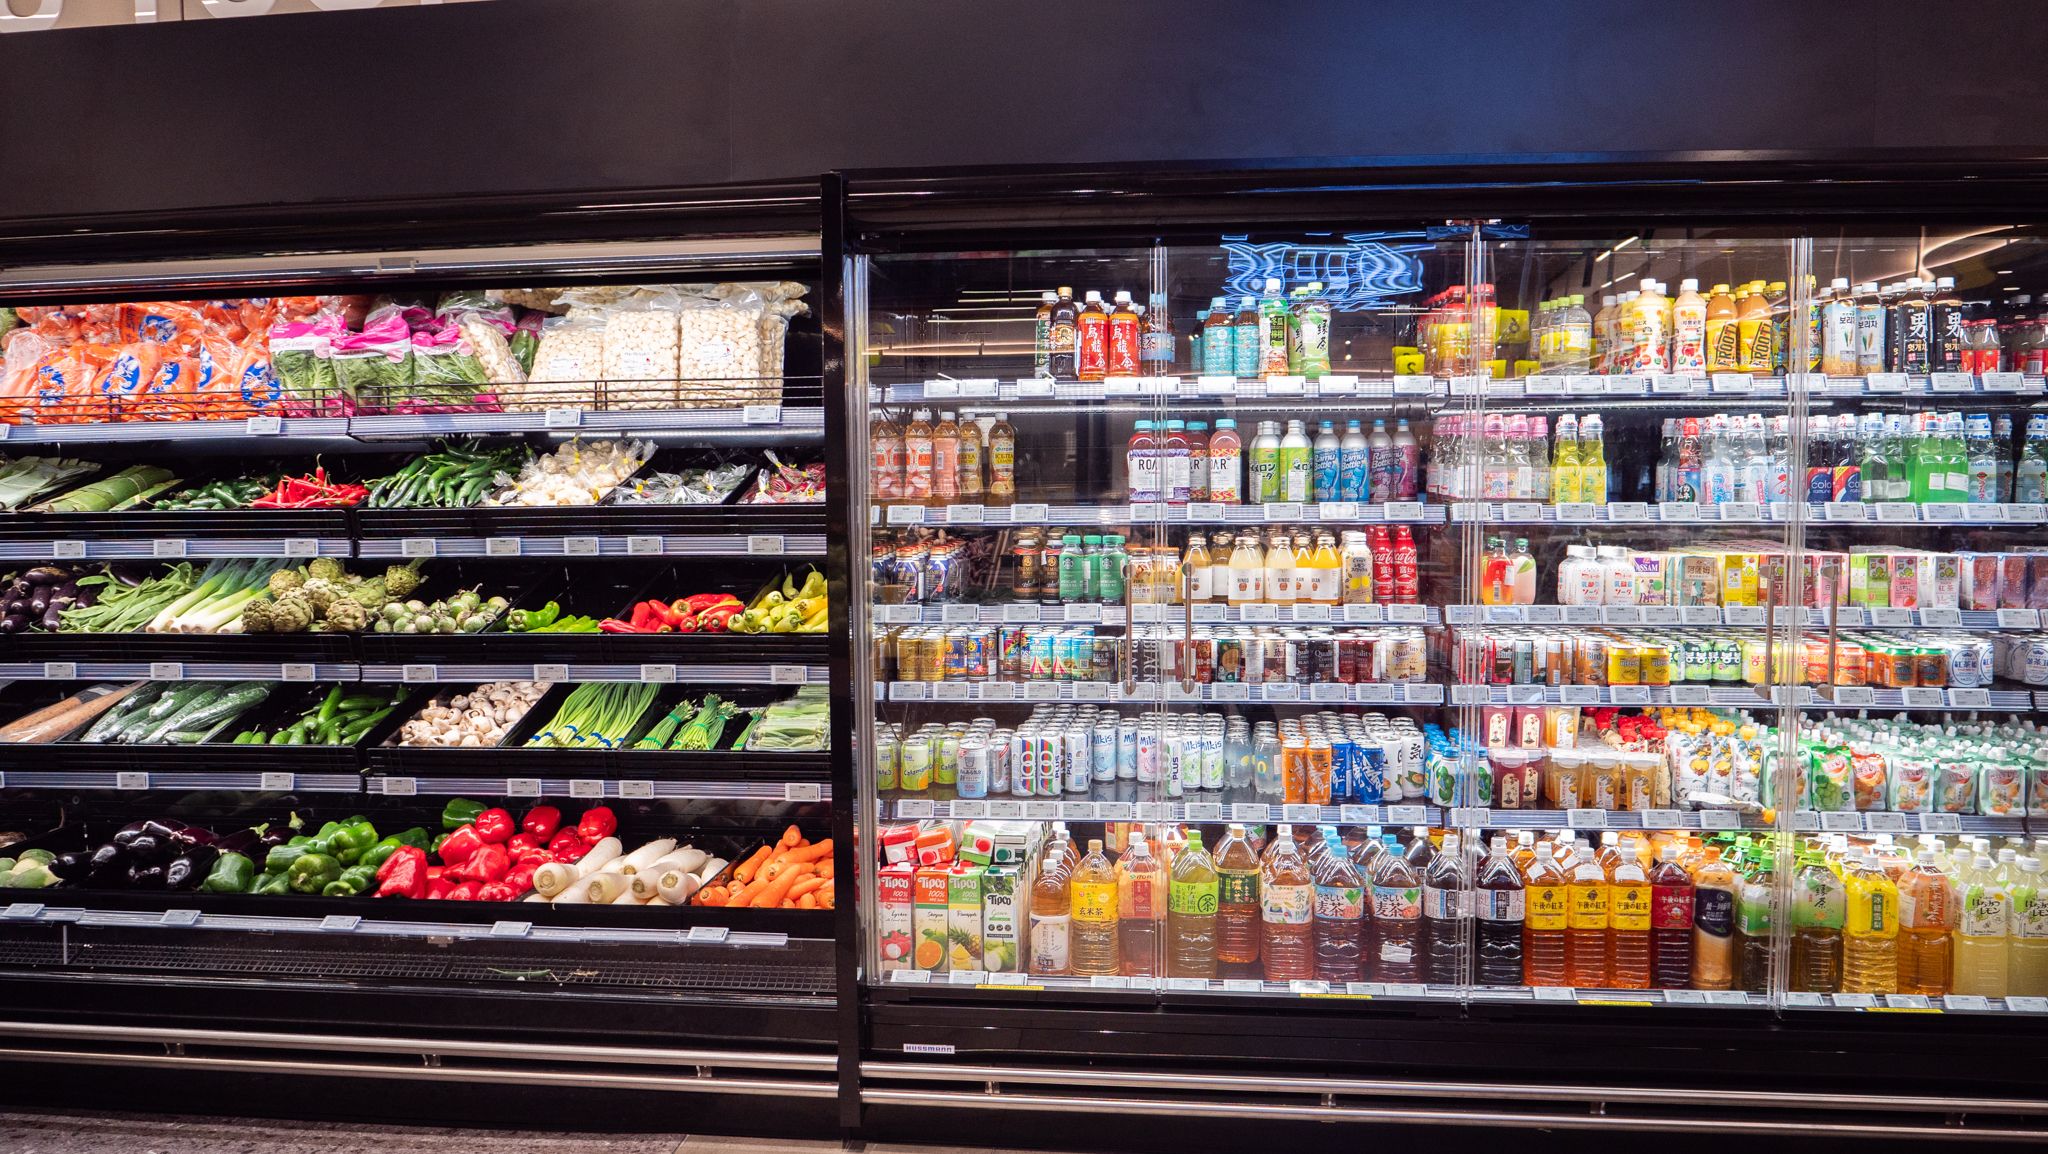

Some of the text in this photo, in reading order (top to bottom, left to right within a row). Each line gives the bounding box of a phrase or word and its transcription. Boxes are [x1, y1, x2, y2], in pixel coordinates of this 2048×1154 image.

[1858, 320, 1878, 328] 보리차
[1910, 312, 1927, 338] 男
[1946, 312, 1962, 337] 男
[881, 876, 908, 888] Tipco
[918, 876, 946, 888] Tipco
[950, 877, 976, 889] Tipco
[987, 894, 1012, 906] Tipco
[1317, 893, 1344, 902] やさしい
[1375, 892, 1404, 902] やさしい
[1202, 898, 1214, 912] 茶
[1317, 902, 1344, 916] 麦茶
[1375, 902, 1404, 916] 麦茶
[1532, 901, 1564, 910] 午後の紅茶
[1577, 901, 1608, 910] 午後の紅茶
[1616, 902, 1649, 910] 午後の紅茶
[1079, 907, 1104, 916] 玄米茶
